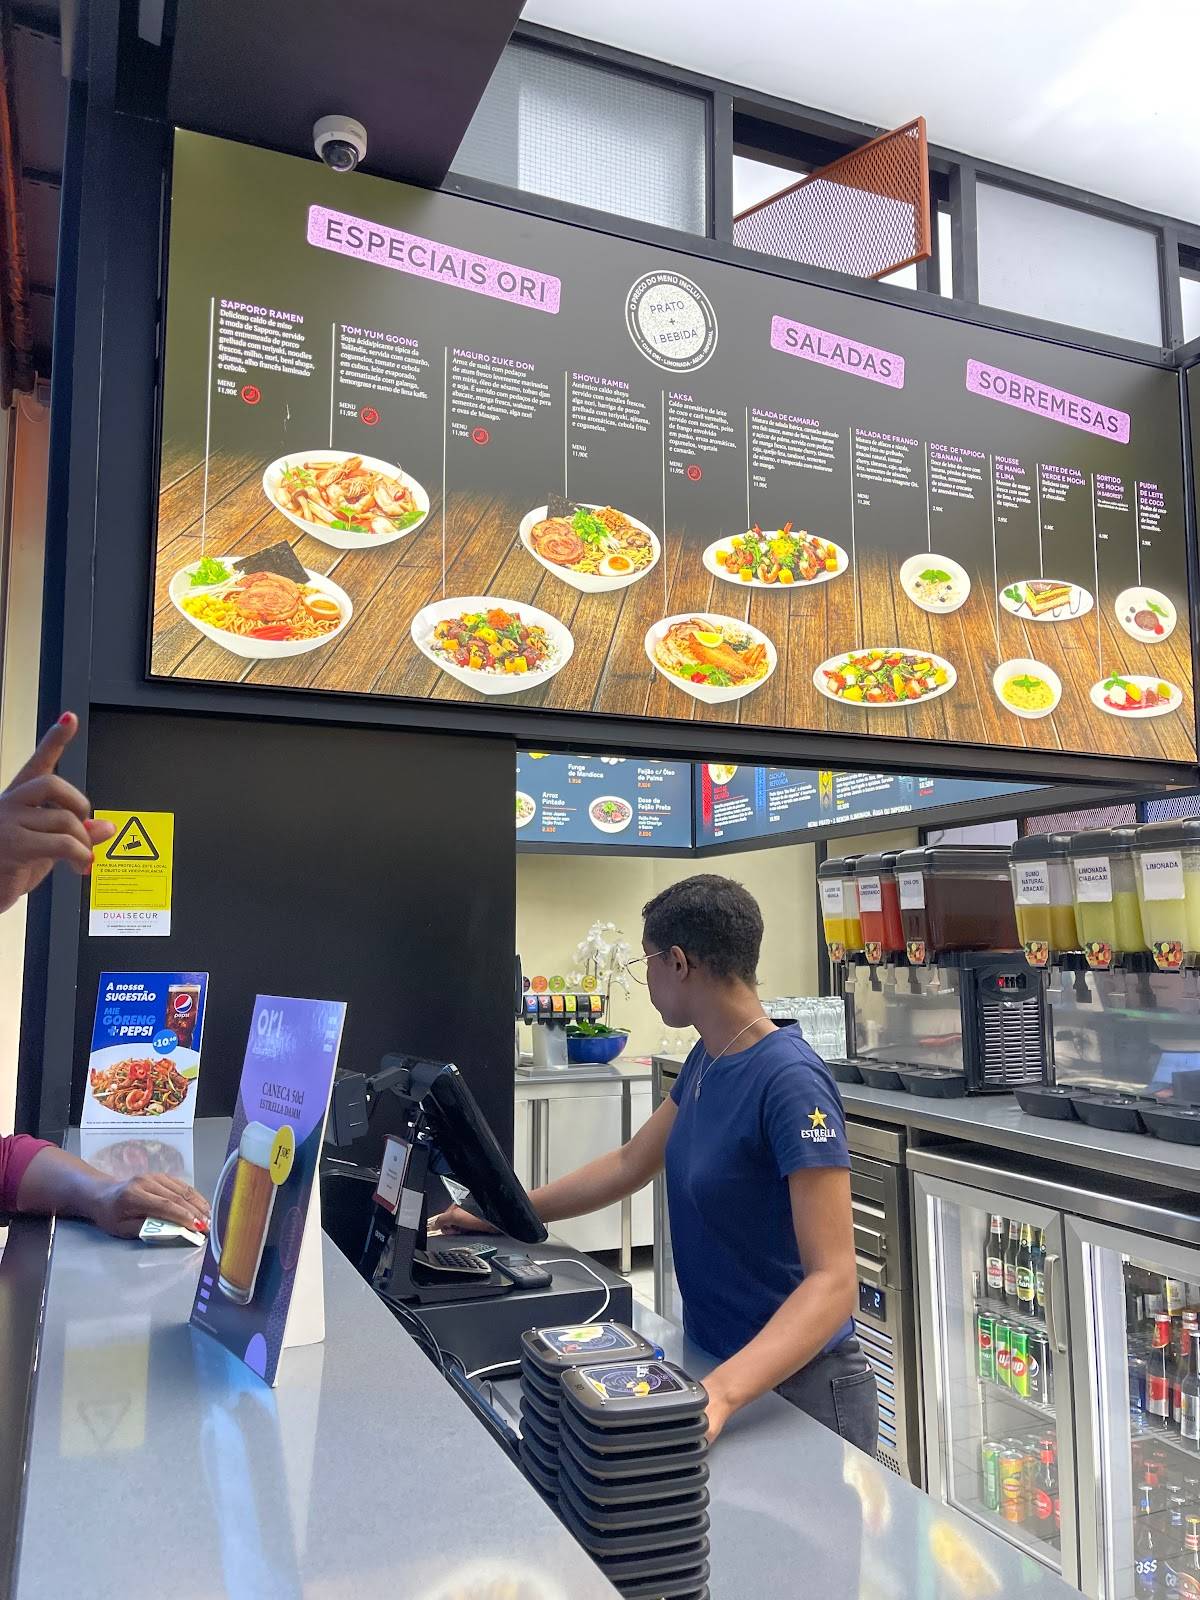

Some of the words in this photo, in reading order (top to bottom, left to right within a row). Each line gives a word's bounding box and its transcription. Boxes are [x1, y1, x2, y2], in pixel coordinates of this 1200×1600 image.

[326, 218, 487, 286] ESPECIAIS
[496, 271, 546, 302] ORI
[632, 282, 647, 304] PREÇO
[646, 276, 656, 286] DO
[679, 280, 701, 300] INCLUI
[221, 299, 267, 316] SAPPORO
[270, 310, 304, 324] RAMEN
[650, 301, 684, 314] PRATO
[282, 332, 304, 341] servido
[340, 324, 361, 335] TOM
[363, 329, 383, 340] YUM
[386, 334, 418, 347] GOONG
[341, 335, 356, 343] Sopa
[659, 329, 697, 343] BEBIDA
[784, 327, 892, 378] SALADAS
[453, 349, 489, 362] MAGURO
[492, 357, 514, 366] ZUKE
[516, 361, 534, 371] DON
[572, 373, 599, 384] SHOYU
[602, 379, 629, 389] RAMEN
[669, 392, 693, 402] LAKSA
[979, 370, 1120, 434] SOBREMESAS
[752, 408, 778, 419] SALADA
[788, 416, 819, 427] CAMARÃO
[855, 429, 881, 439] SALADA
[893, 436, 919, 446] FRANGO
[930, 443, 948, 451] DOCE
[960, 448, 985, 459] TAPIOCA
[930, 452, 963, 462] C/BANANA
[995, 456, 1019, 465] MOUSSE
[1005, 466, 1025, 474] MANGA
[1041, 464, 1059, 473] TARTE
[1042, 472, 1061, 481] VERDE
[1067, 477, 1086, 486] MOCHI
[1145, 861, 1179, 870] LIMONADA
[106, 982, 114, 991] A
[105, 990, 156, 1001] SUGESTÃO
[103, 1015, 156, 1025] GORENG
[120, 1026, 153, 1036] PEPSI
[262, 1082, 290, 1101] CANECA
[801, 1129, 836, 1138] ESTRELLA
